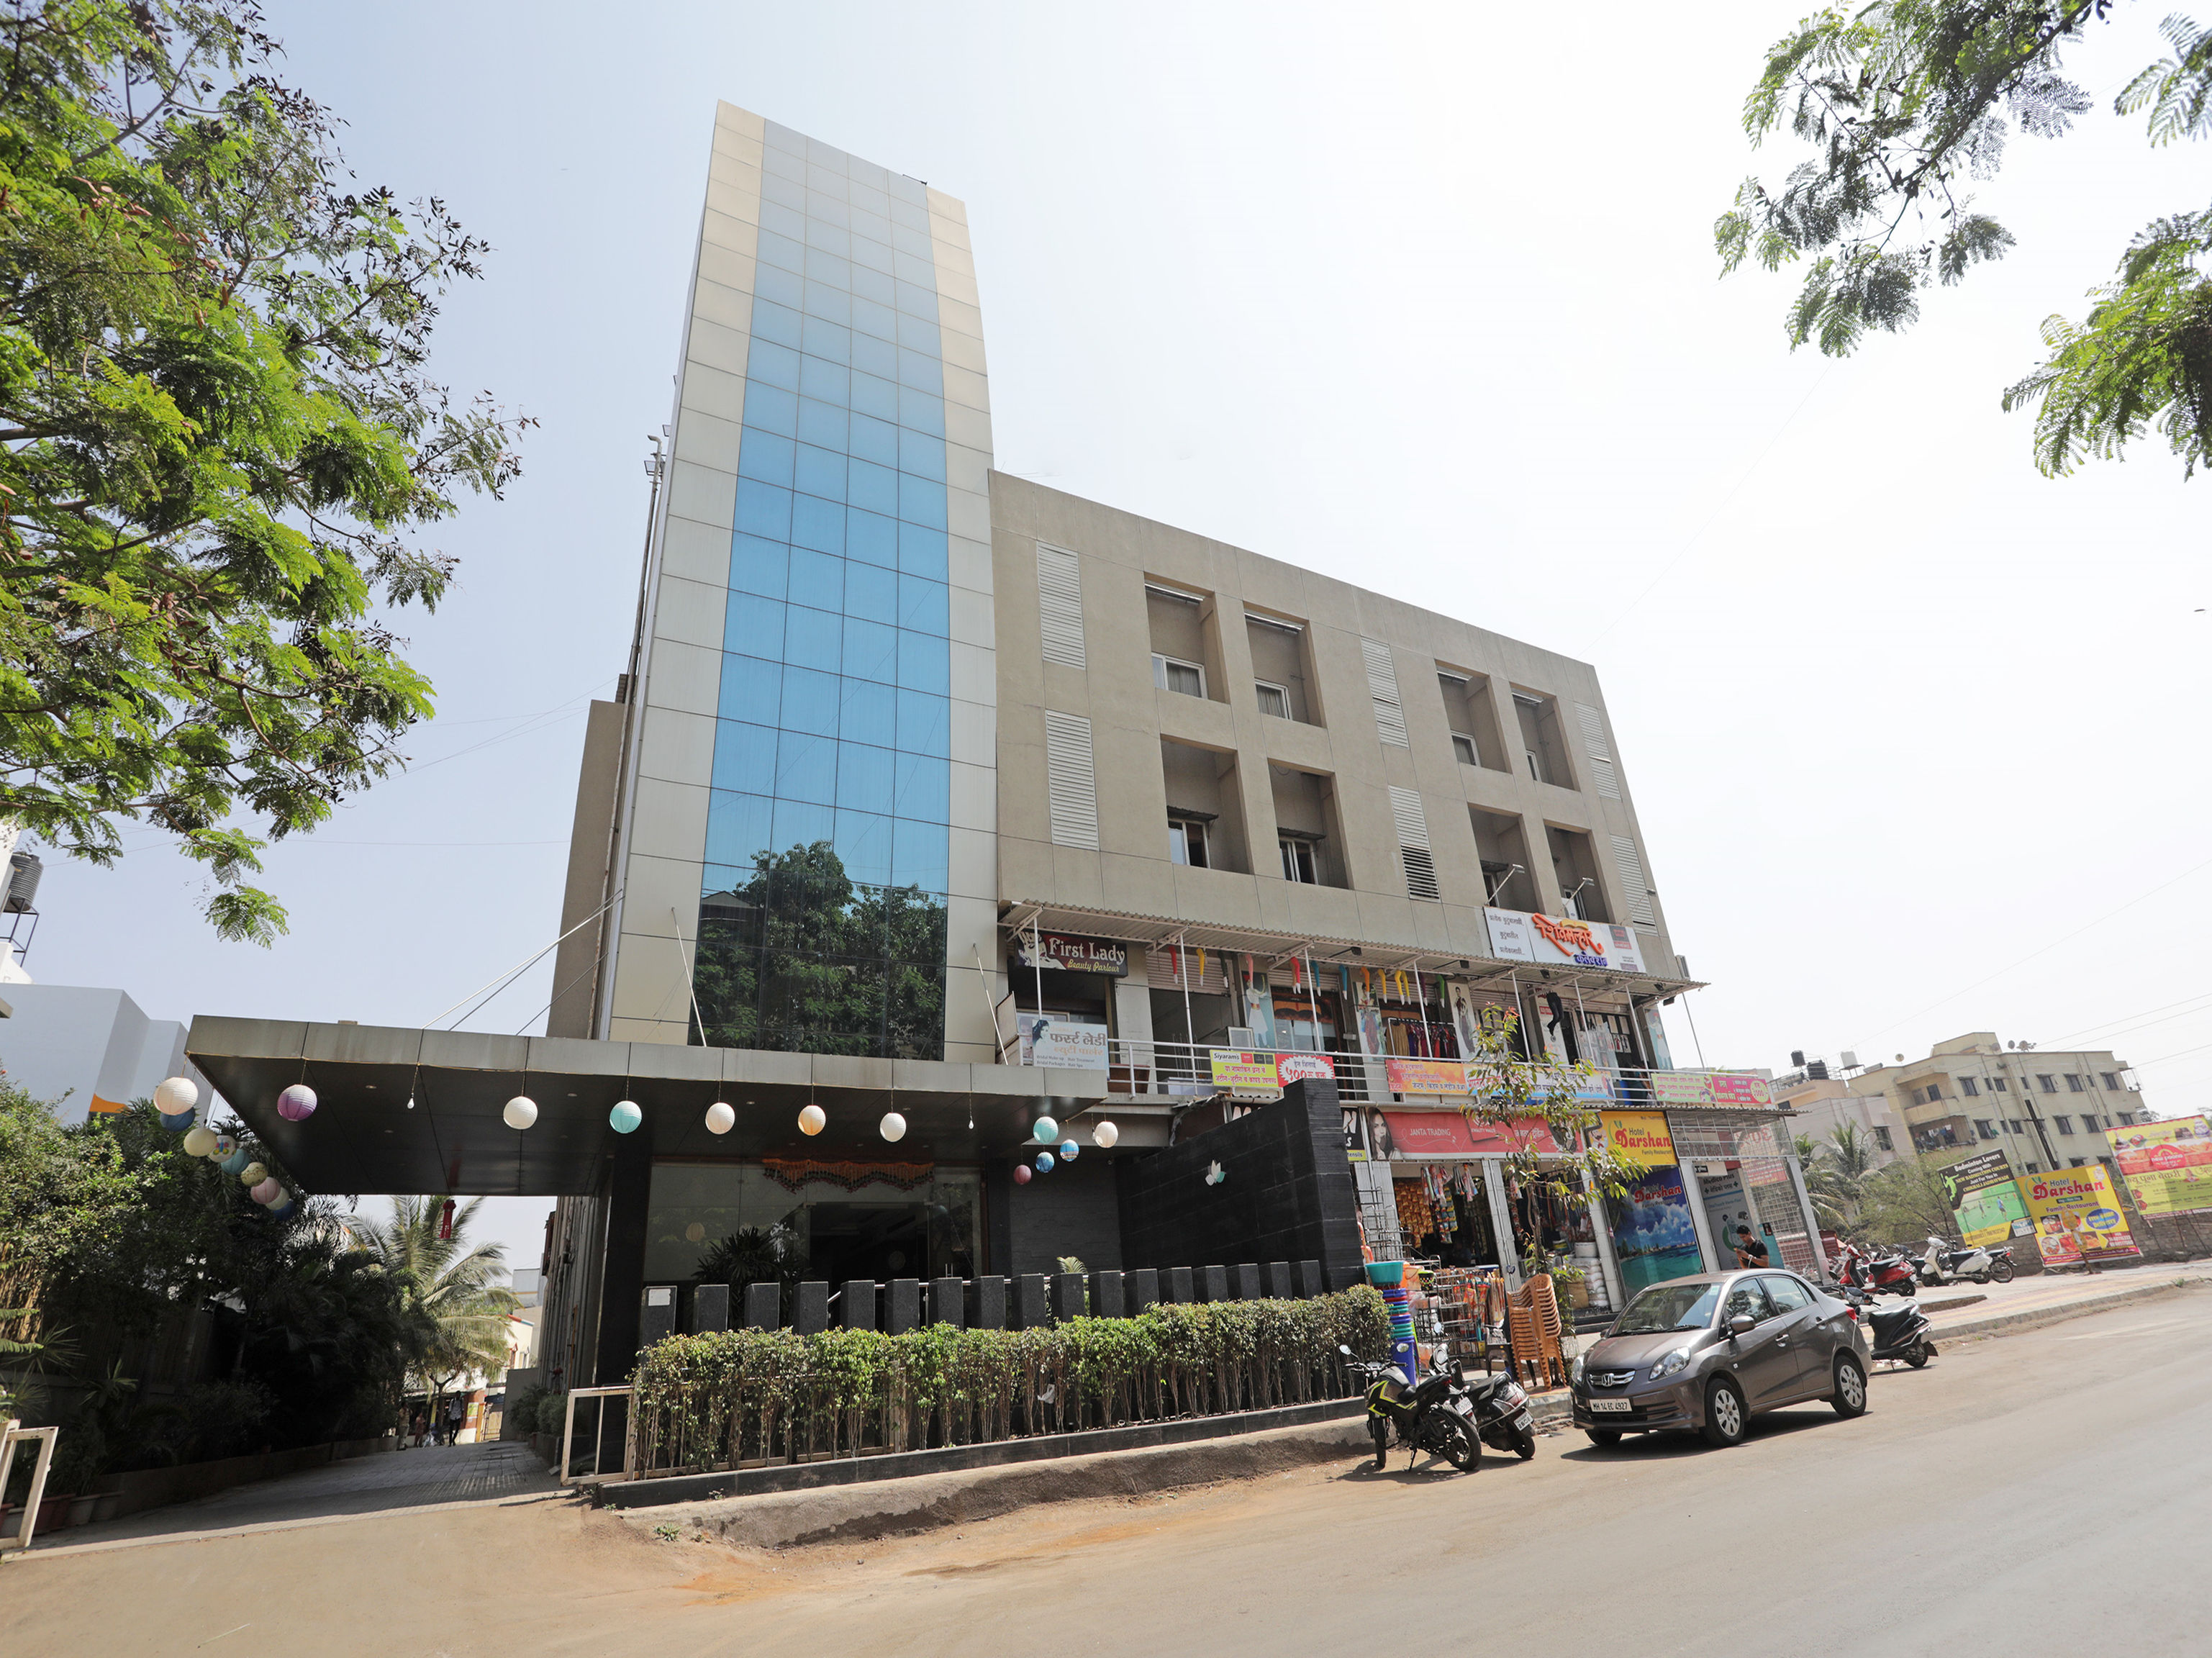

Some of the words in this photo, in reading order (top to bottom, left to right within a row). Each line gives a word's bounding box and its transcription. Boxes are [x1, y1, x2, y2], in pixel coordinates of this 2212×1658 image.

[1049, 937, 1084, 958] First
[1089, 942, 1125, 965] Lady
[1067, 959, 1092, 971] Beauty
[1093, 961, 1119, 972] Parlour
[1050, 1031, 1080, 1044] फर्स्ट
[1082, 1032, 1107, 1046] लेडी
[1214, 1053, 1240, 1061] Siyaram's
[1410, 1128, 1426, 1136] JANTA
[1428, 1128, 1451, 1136] TRADING
[1615, 1128, 1671, 1148] Darshan
[1954, 1157, 1982, 1172] Badminton
[1982, 1154, 2000, 1163] Lovers
[2033, 1180, 2105, 1200] Darshan
[2050, 1178, 2070, 1187] Hotel
[1634, 1185, 1682, 1203] Darshan
[2067, 1201, 2100, 1210] Restaurant
